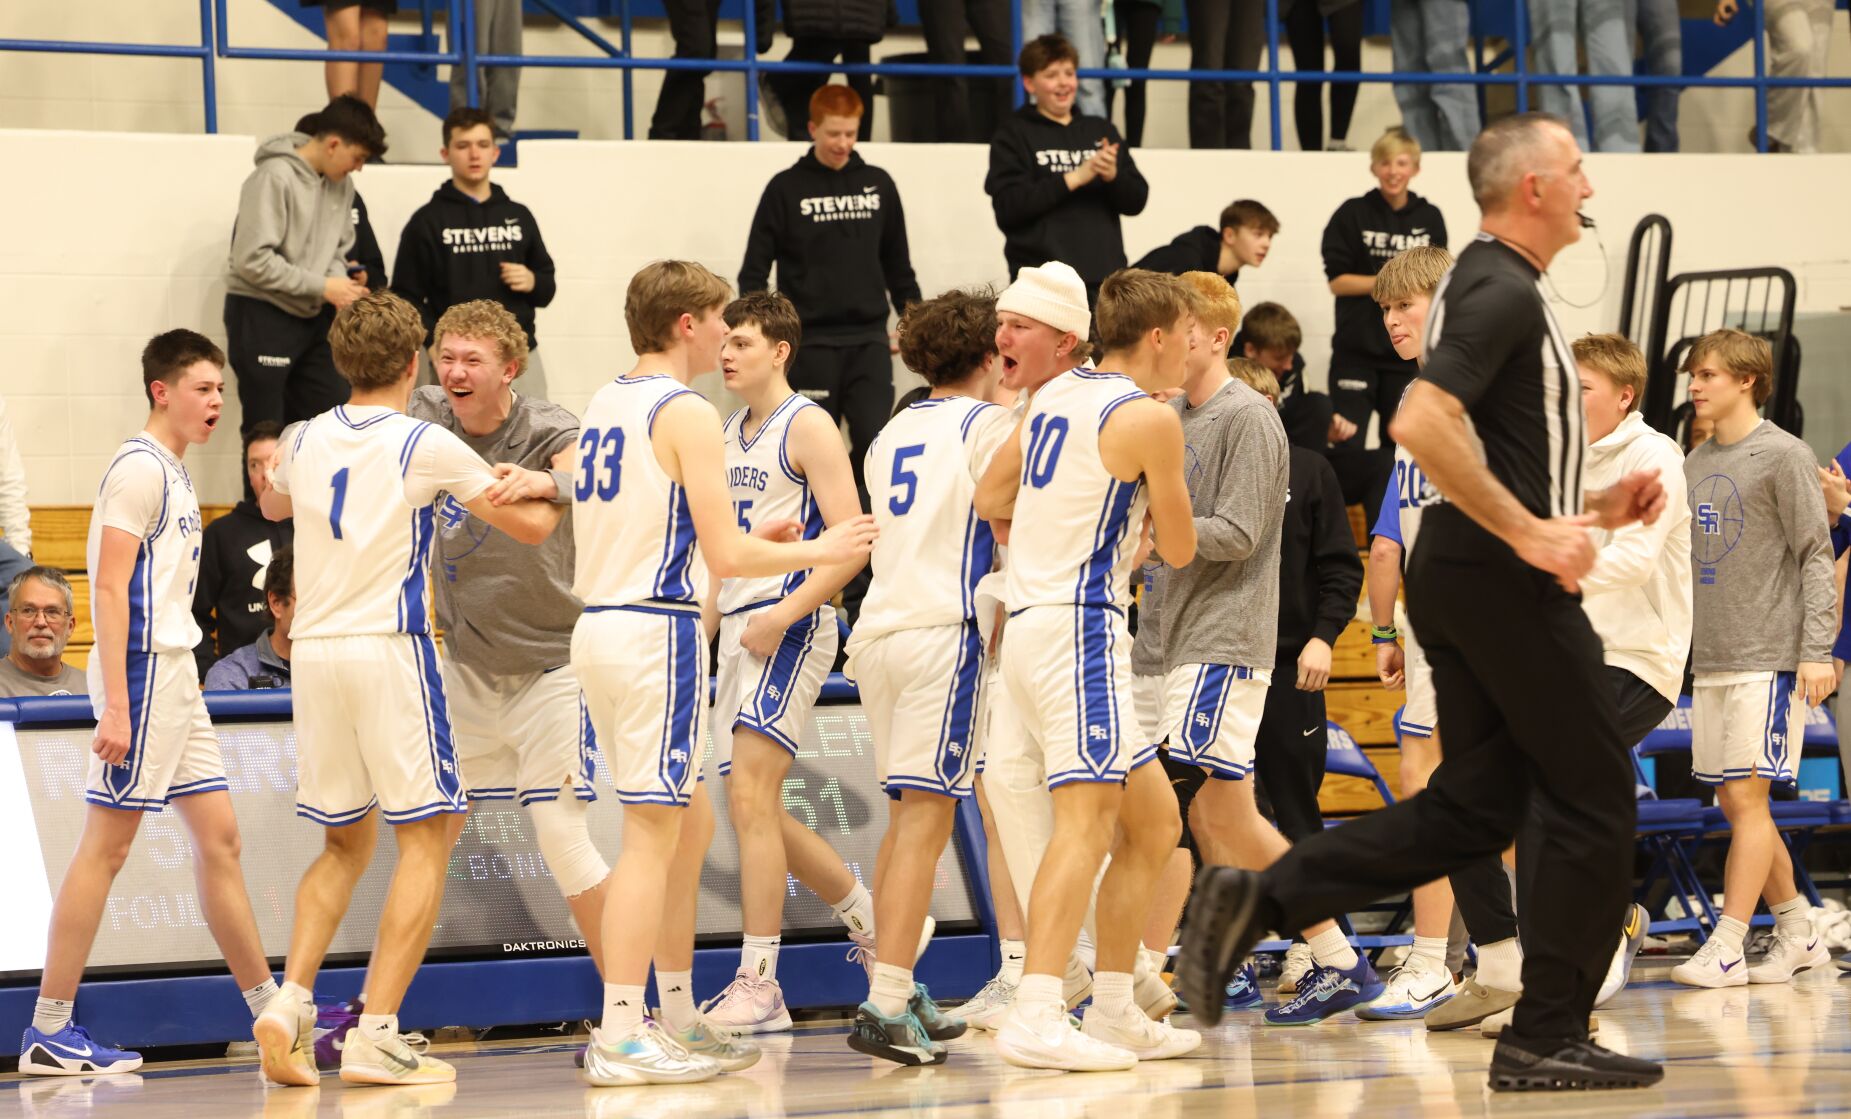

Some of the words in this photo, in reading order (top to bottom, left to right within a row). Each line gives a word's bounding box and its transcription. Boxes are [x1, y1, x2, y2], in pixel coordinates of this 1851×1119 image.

[442, 225, 522, 245] STEVENS
[575, 426, 625, 502] 33
[1022, 412, 1069, 489] 10
[328, 467, 350, 540] 1
[725, 465, 769, 492] IDERS
[888, 443, 926, 516] 5
[1089, 724, 1109, 740] SR
[503, 939, 587, 953] DAKTRONICS
